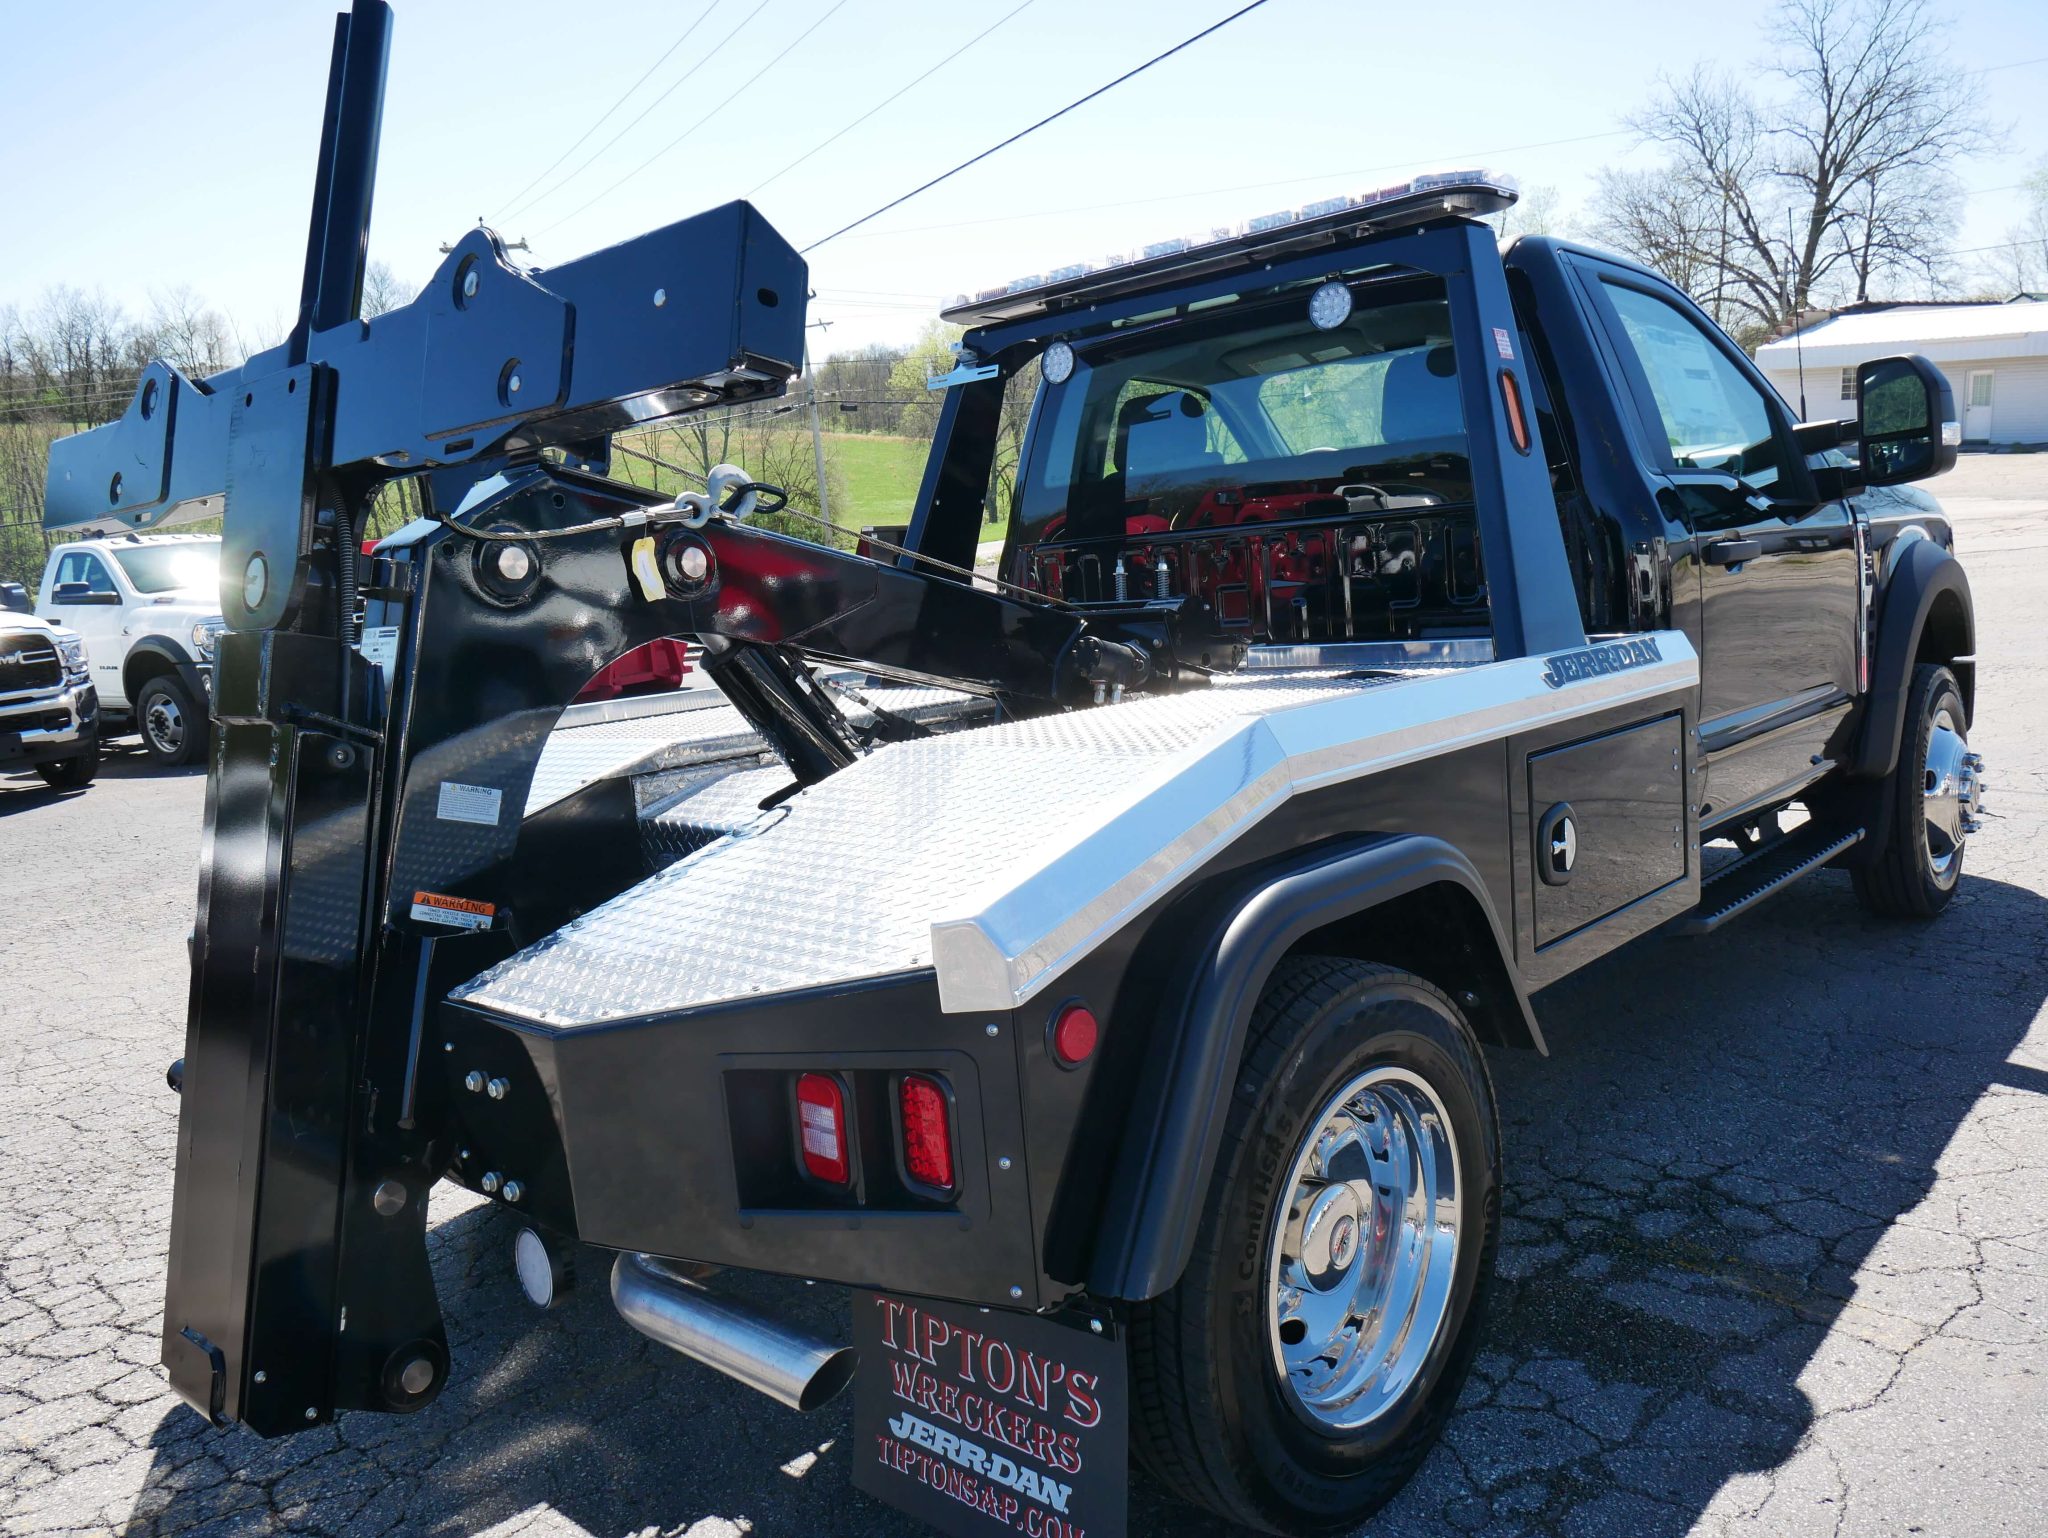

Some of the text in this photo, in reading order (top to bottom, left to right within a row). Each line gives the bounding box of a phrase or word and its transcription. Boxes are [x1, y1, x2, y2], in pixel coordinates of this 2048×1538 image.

[459, 785, 492, 796] WARNING
[434, 896, 486, 913] WARNING
[873, 1294, 1101, 1427] TIPTON'S
[888, 1358, 1082, 1474] WRECKERS
